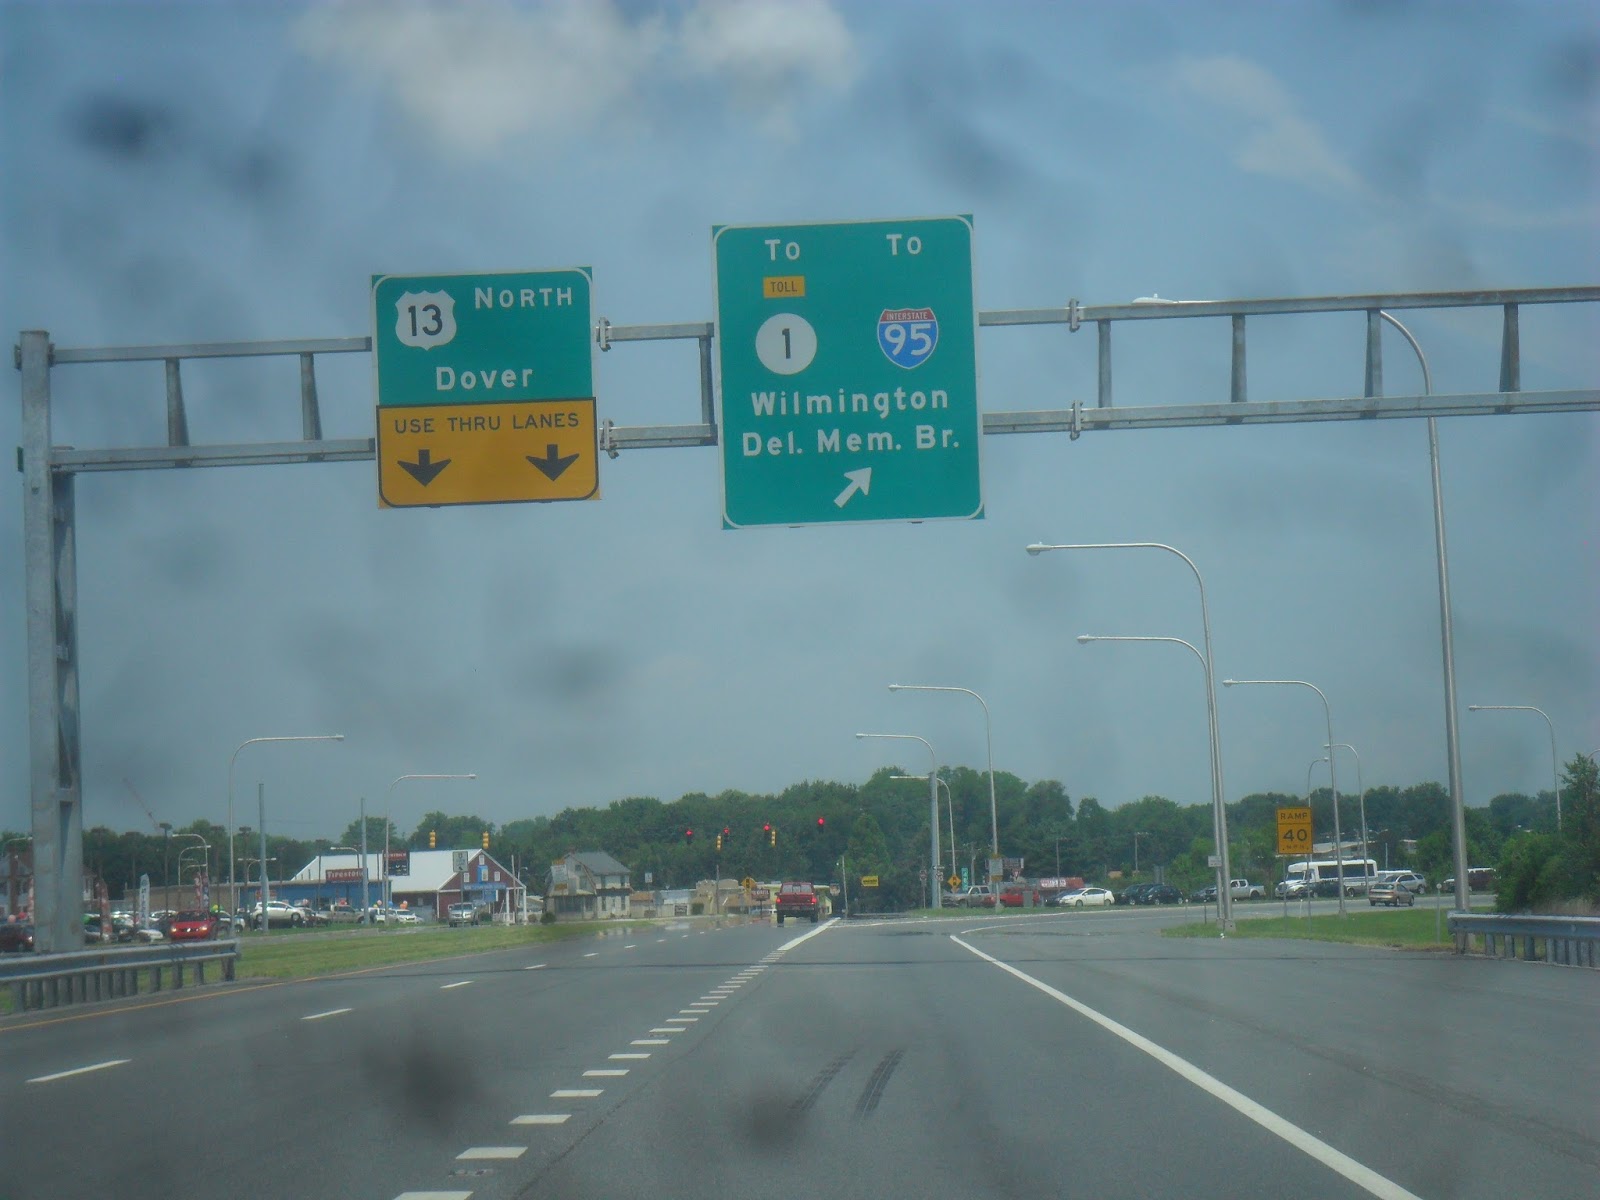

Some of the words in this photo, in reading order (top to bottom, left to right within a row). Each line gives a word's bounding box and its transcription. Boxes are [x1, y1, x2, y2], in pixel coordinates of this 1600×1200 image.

[474, 286, 573, 310] NORTH
[769, 280, 798, 294] TOLL
[407, 303, 444, 337] 13
[886, 311, 928, 321] INTERSTATE
[781, 328, 791, 360] 1
[884, 323, 932, 356] 95
[435, 366, 534, 391] Dover
[751, 386, 949, 419] Wilmington
[394, 418, 435, 434] USE
[447, 415, 501, 432] THRU
[512, 412, 580, 430] LANES
[742, 431, 803, 457] Del.
[817, 428, 902, 454] Mem.
[915, 424, 960, 450] Br.
[1280, 812, 1308, 820] RAMP
[1283, 828, 1308, 842] 40
